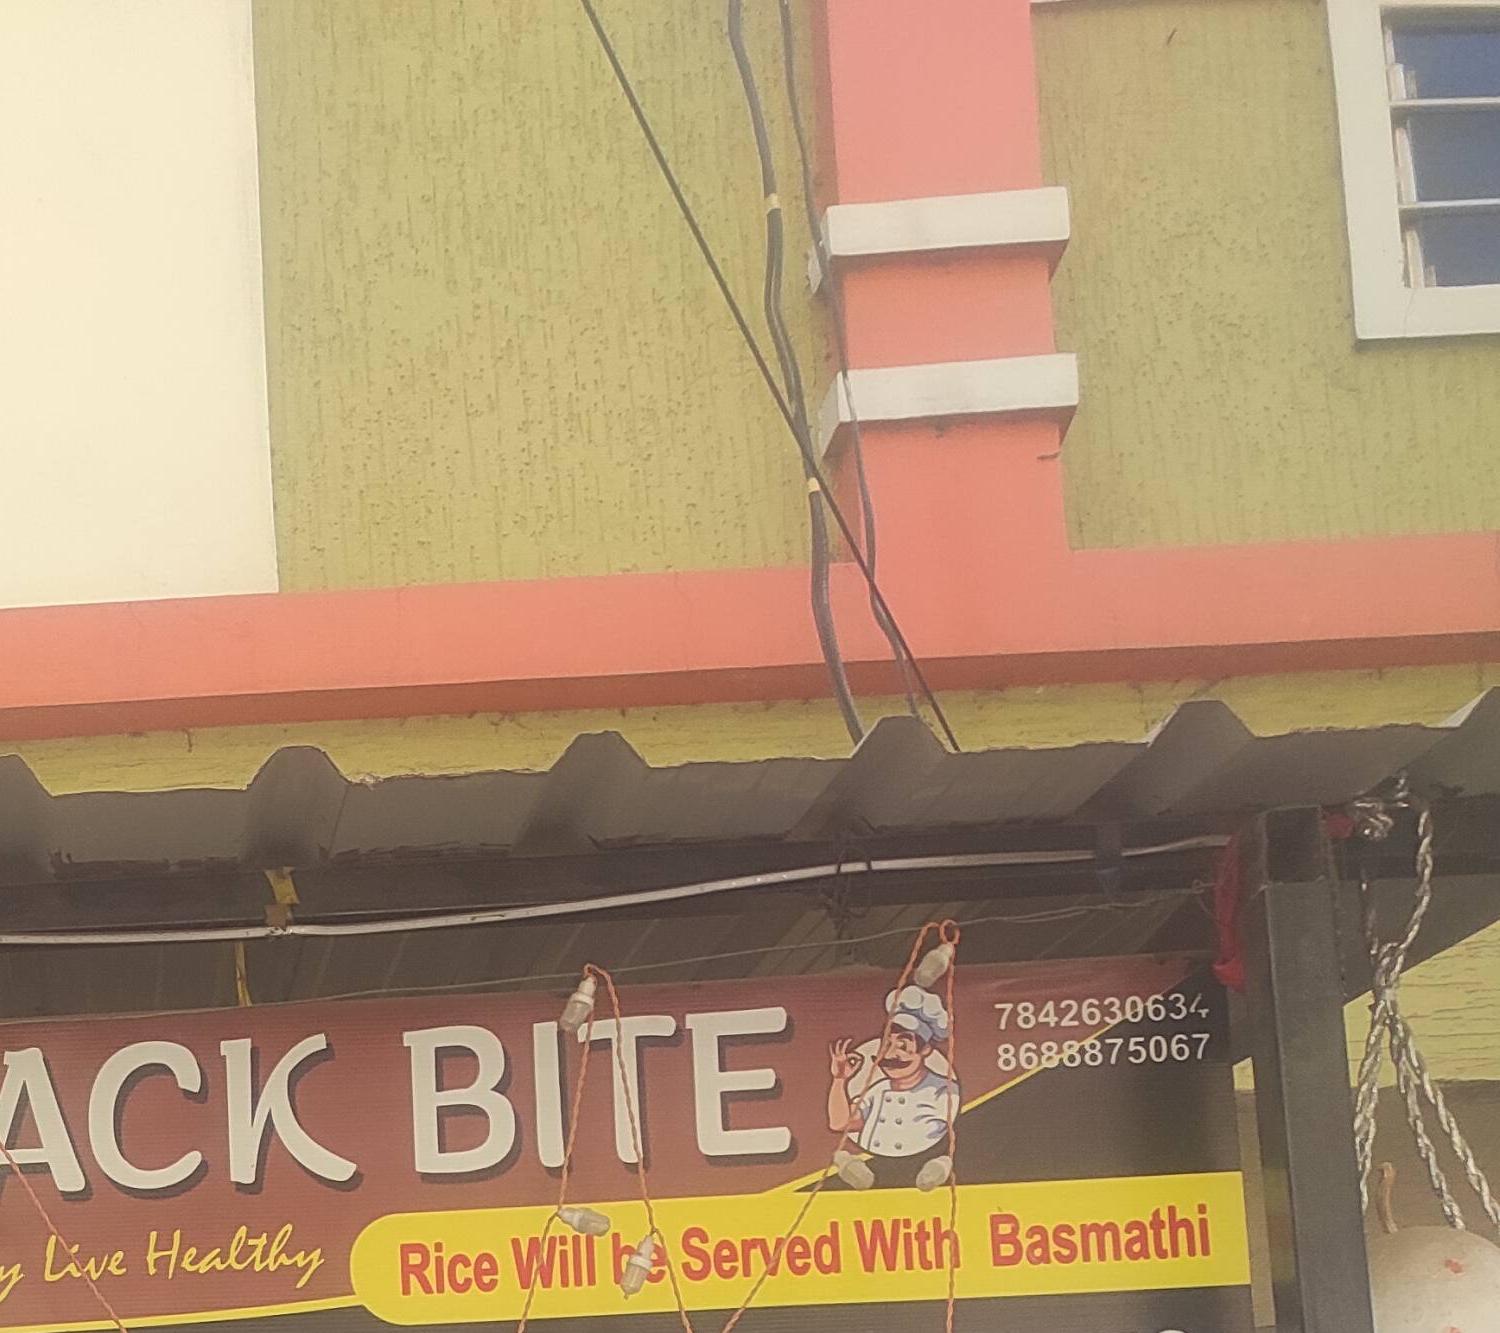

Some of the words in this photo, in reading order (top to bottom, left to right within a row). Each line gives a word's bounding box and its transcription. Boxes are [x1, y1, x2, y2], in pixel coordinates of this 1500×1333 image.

[994, 992, 1210, 1030] 7842630634
[997, 1033, 1211, 1071] 8688875067
[403, 1006, 792, 1176] BITE
[44, 1235, 127, 1283] Live
[146, 1223, 325, 1289] Healthy
[399, 1241, 499, 1297] Rice
[510, 1232, 597, 1290] Will
[611, 1232, 668, 1285] be
[681, 1220, 842, 1281] Served
[853, 1216, 961, 1274] With
[991, 1203, 1211, 1268] Basmathi
